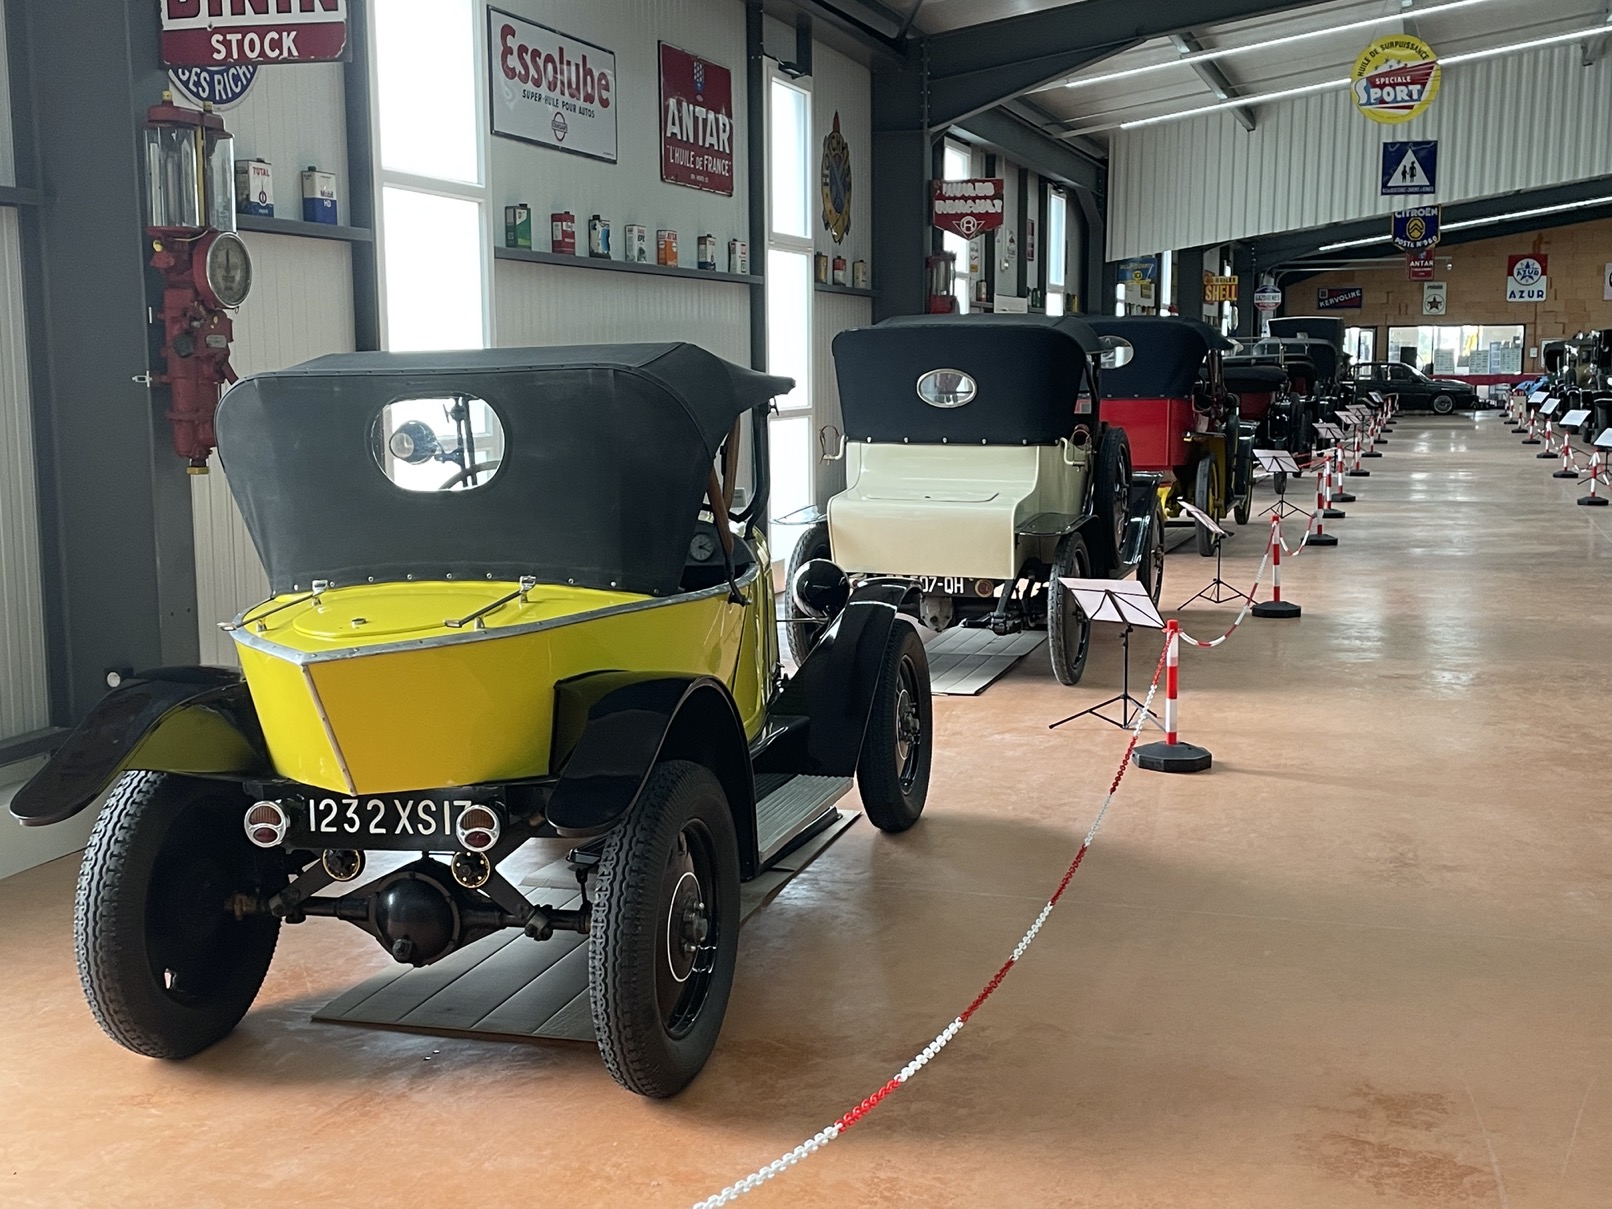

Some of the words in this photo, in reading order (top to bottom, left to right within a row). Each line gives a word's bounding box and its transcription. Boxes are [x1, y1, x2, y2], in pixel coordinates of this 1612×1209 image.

[210, 30, 299, 61] STOCK
[500, 23, 611, 109] Essolube
[1357, 56, 1371, 77] HUILE
[1369, 48, 1380, 58] DE
[1380, 40, 1430, 60] SURPUISSANCE
[1375, 75, 1412, 85] SPECIALE
[1355, 78, 1422, 104] SPORT
[561, 100, 577, 113] POUR
[578, 102, 596, 119] AUTOS
[666, 97, 731, 154] ANTAR
[252, 166, 271, 178] TOTAL
[695, 156, 704, 171] DE
[320, 189, 334, 199] Mobil
[1516, 269, 1540, 277] AZUR
[1205, 284, 1238, 302] SHELL
[1319, 289, 1362, 308] KERVOLINE
[1508, 289, 1545, 300] AZUR
